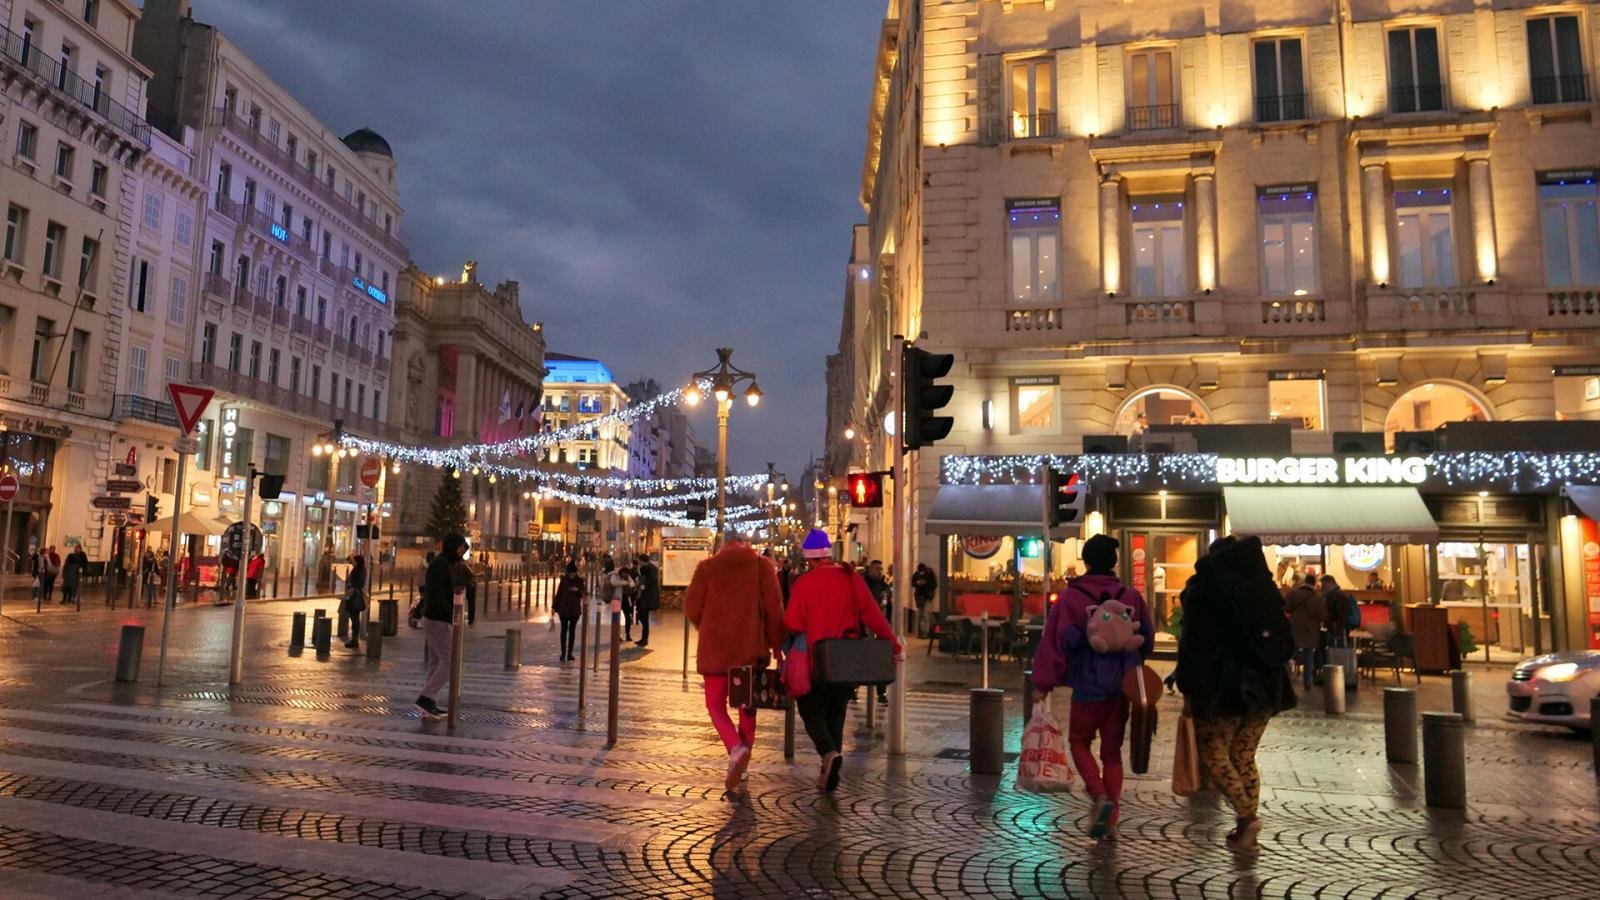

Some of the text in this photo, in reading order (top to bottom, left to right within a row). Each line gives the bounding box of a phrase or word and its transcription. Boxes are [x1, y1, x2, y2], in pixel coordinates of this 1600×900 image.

[1216, 457, 1428, 484] BURGER KING
[1294, 534, 1312, 544] OF
[1314, 534, 1342, 544] THE
[1344, 534, 1410, 544] WHOPPER
